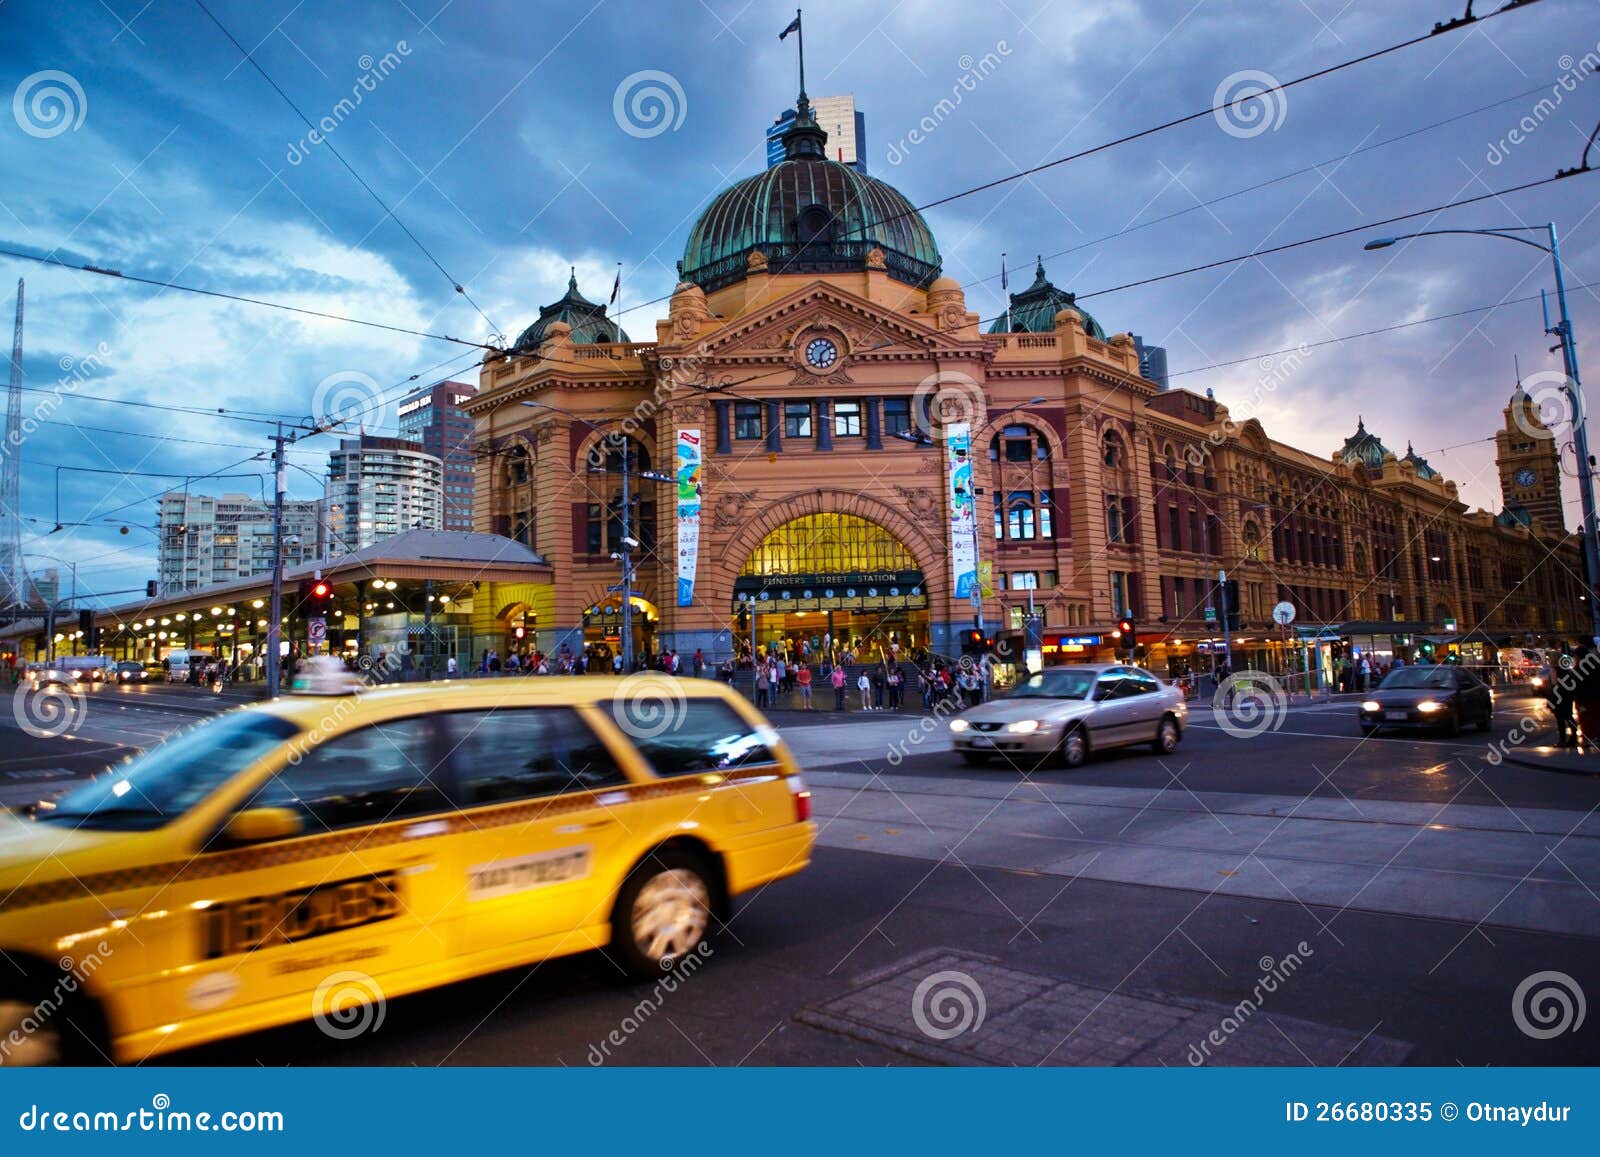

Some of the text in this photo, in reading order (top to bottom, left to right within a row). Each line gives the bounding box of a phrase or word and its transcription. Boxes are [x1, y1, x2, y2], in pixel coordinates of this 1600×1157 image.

[763, 574, 897, 585] FLINDERS STREET STATION
